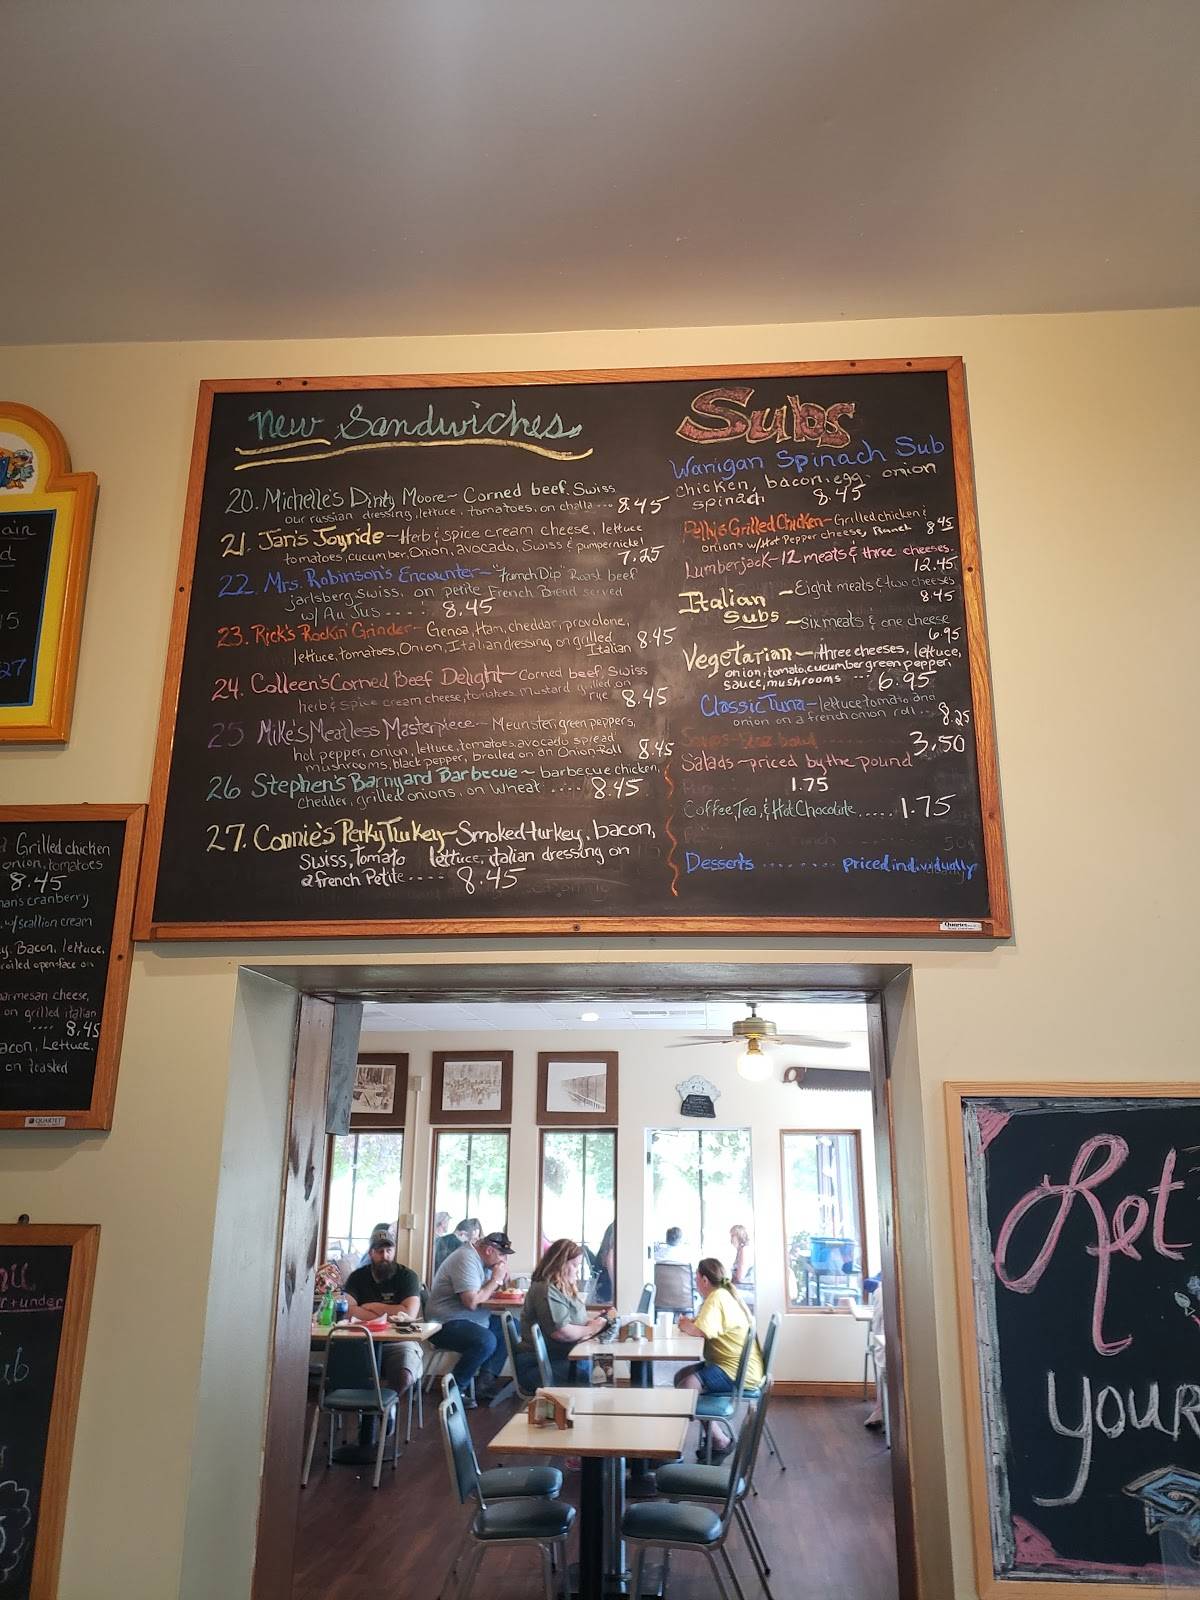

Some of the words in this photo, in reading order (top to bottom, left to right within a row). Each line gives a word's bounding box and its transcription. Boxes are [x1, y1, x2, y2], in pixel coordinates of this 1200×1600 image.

[248, 409, 324, 440] New
[334, 398, 583, 440] Sandwiches
[676, 387, 856, 448] Subs
[668, 456, 763, 480] Wanigan
[776, 440, 887, 473] Spinach
[895, 434, 944, 457] Sub
[882, 462, 936, 478] onion
[225, 487, 260, 514] 20.
[262, 487, 345, 512] Michelle's
[463, 483, 522, 504] Corned
[573, 482, 616, 496] Swiss
[692, 491, 765, 512] spinach
[813, 484, 866, 506] 8.45
[285, 514, 305, 525] our
[309, 511, 353, 524] russian
[540, 503, 555, 512] on
[729, 514, 776, 537] Grilled
[445, 526, 481, 544] spice
[484, 525, 534, 537] cream
[602, 522, 643, 534] lettuce
[522, 540, 563, 552] Swiss
[617, 545, 664, 566] 7.25
[701, 541, 744, 553] onions
[804, 547, 847, 564] meats
[862, 545, 897, 560] three
[914, 556, 959, 572] 12.45
[304, 564, 393, 589] Robinson's
[608, 567, 638, 581] beef
[413, 587, 434, 598] on
[444, 582, 482, 598] petite
[488, 583, 534, 599] French
[537, 584, 577, 598] Bread
[678, 586, 766, 615] Italian
[837, 578, 874, 592] meats
[920, 589, 956, 602] 8.45
[324, 609, 345, 621] Au
[350, 602, 381, 620] Jus
[442, 597, 496, 618] 8.45
[822, 610, 864, 628] meats
[881, 617, 903, 627] one
[907, 614, 950, 626] cheese
[216, 625, 249, 648] 23.
[251, 623, 296, 647] Rick's
[446, 638, 502, 654] Italian
[503, 635, 553, 653] dressing
[586, 643, 632, 657] Italian
[636, 626, 677, 650] 8.45
[929, 626, 961, 644] 6.95
[682, 640, 792, 678] Vegetarian
[807, 660, 865, 673] cucumber
[865, 659, 902, 673] green
[211, 677, 244, 701] 24.
[250, 671, 330, 695] Colleen's
[330, 671, 389, 692] Corned
[393, 670, 434, 688] Beef
[519, 665, 562, 681] Corned
[607, 665, 648, 677] Swiss
[766, 674, 841, 690] mushrooms
[878, 670, 937, 692] 6.95
[622, 686, 669, 708] 8.45
[700, 693, 766, 717] Classic
[733, 716, 769, 727] onion
[776, 716, 792, 725] on
[938, 701, 970, 727] 8.25
[257, 718, 309, 746] Mike's
[309, 717, 381, 744] Meatless
[558, 718, 588, 735] green
[393, 756, 421, 769] black
[472, 749, 515, 762] broiled
[518, 751, 534, 759] on
[638, 738, 675, 760] 8.45
[681, 750, 734, 772] Salads
[805, 753, 827, 776] by
[826, 752, 855, 769] the
[856, 751, 913, 773] pound
[206, 774, 241, 801] 26
[251, 772, 346, 799] Stephen's
[350, 769, 433, 796] Barnyard
[540, 765, 611, 780] barbecue
[356, 789, 403, 810] grilled
[466, 786, 485, 795] on
[489, 779, 541, 794] Wheat
[591, 776, 644, 799] 8.45
[791, 776, 829, 792] 1.75
[901, 793, 957, 819] 1.75
[16, 831, 62, 856] Grilled
[206, 823, 247, 852] 27.
[253, 821, 336, 852] Connie's
[48, 858, 103, 872] tomatoes
[542, 846, 604, 865] dressing
[608, 846, 630, 857] on
[685, 851, 754, 873] Desserts
[10, 871, 68, 894] 8.45
[456, 866, 527, 895] 8.45
[27, 891, 89, 909] cranberry
[60, 916, 93, 928] cream
[4, 1008, 19, 1016] on
[24, 1005, 60, 1023] grilled
[5, 1062, 22, 1072] on
